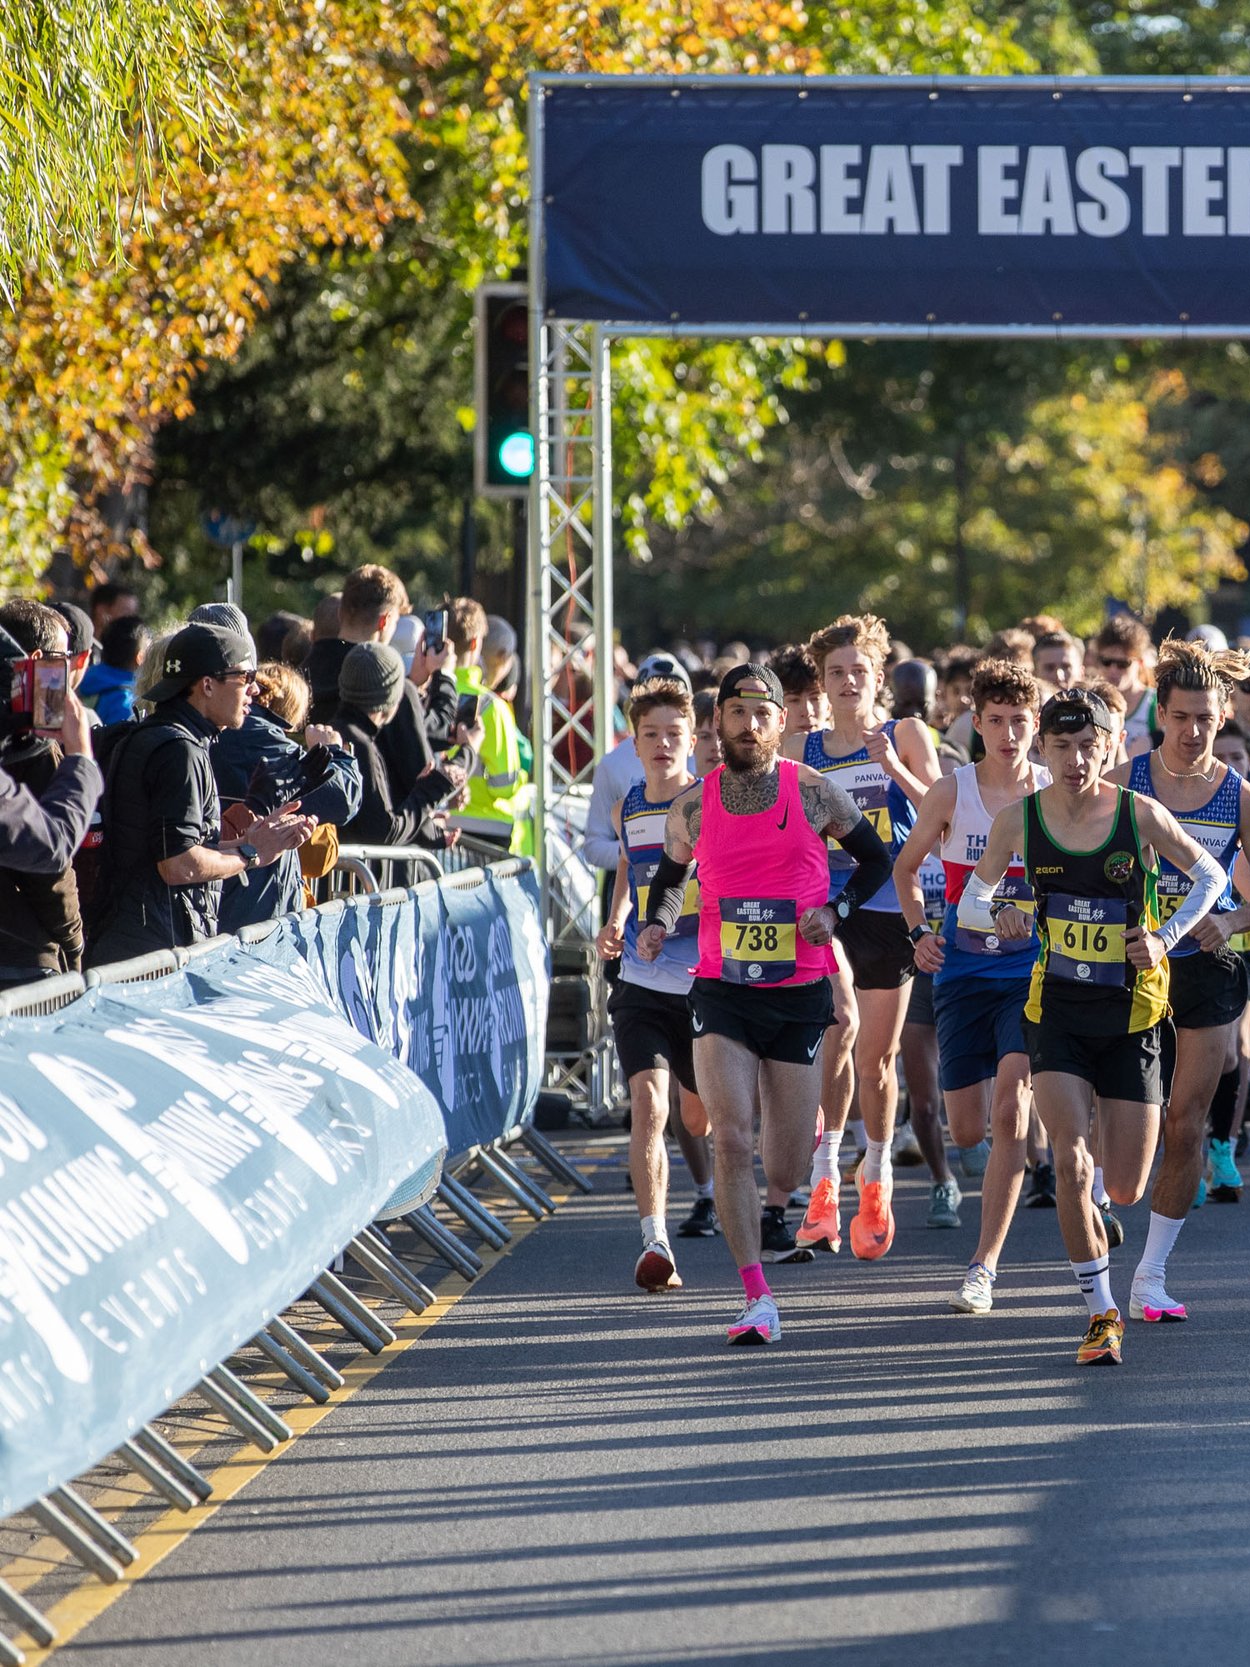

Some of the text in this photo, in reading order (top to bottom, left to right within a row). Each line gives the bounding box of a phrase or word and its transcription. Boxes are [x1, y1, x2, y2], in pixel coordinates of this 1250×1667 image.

[701, 143, 963, 236] GREAT
[743, 901, 760, 909] GREAT
[1068, 905, 1091, 914] EASTERN
[1073, 899, 1091, 907] GREAT
[1078, 913, 1091, 921] RUN
[735, 925, 778, 952] 738
[1063, 923, 1107, 952] 616
[79, 1247, 207, 1354] EVENTS
